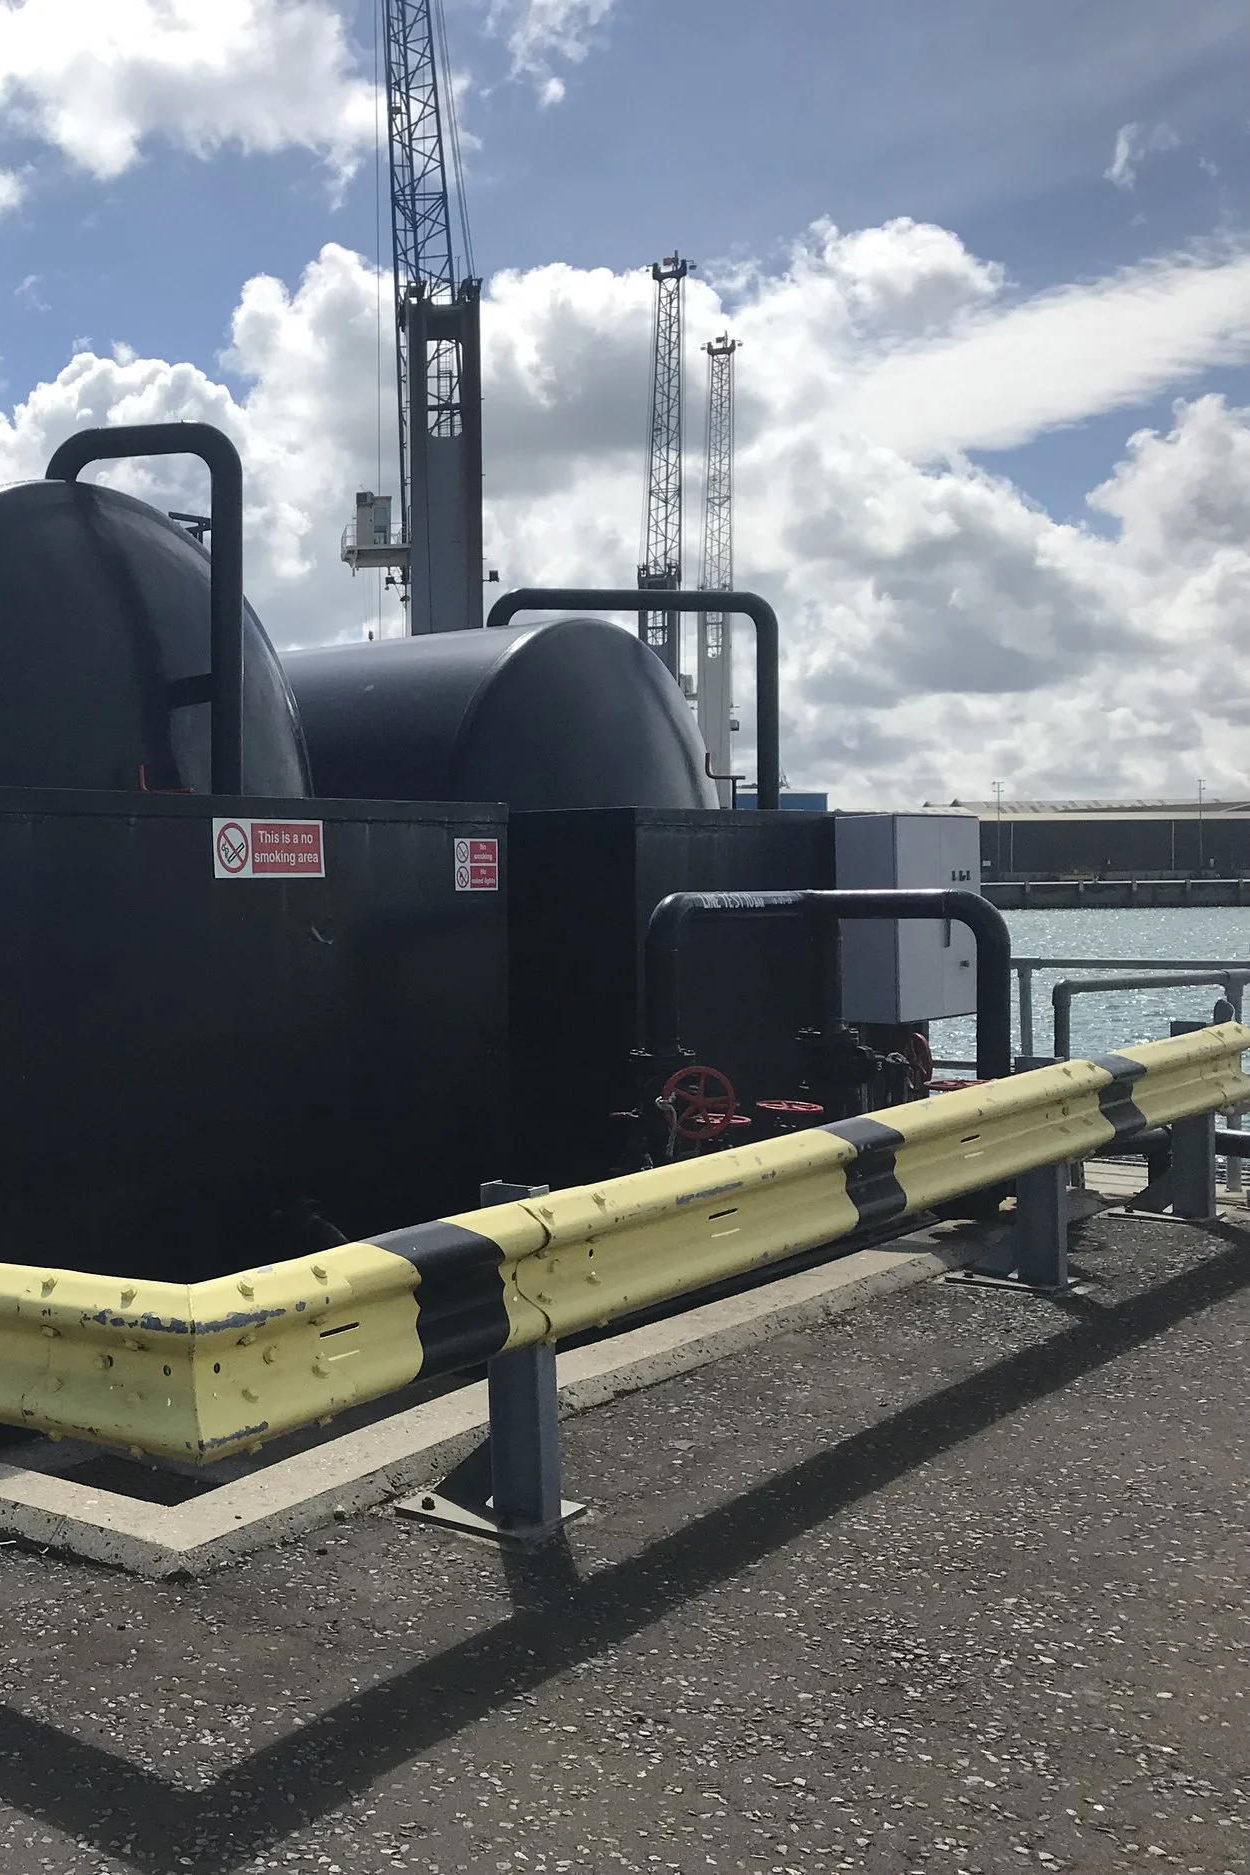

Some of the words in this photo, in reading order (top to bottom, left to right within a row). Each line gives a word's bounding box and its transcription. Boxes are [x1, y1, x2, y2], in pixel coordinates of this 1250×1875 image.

[258, 831, 280, 844] This
[282, 831, 291, 844] is
[293, 834, 299, 844] a
[301, 834, 313, 844] no
[254, 850, 296, 866] smoking
[298, 852, 319, 863] area
